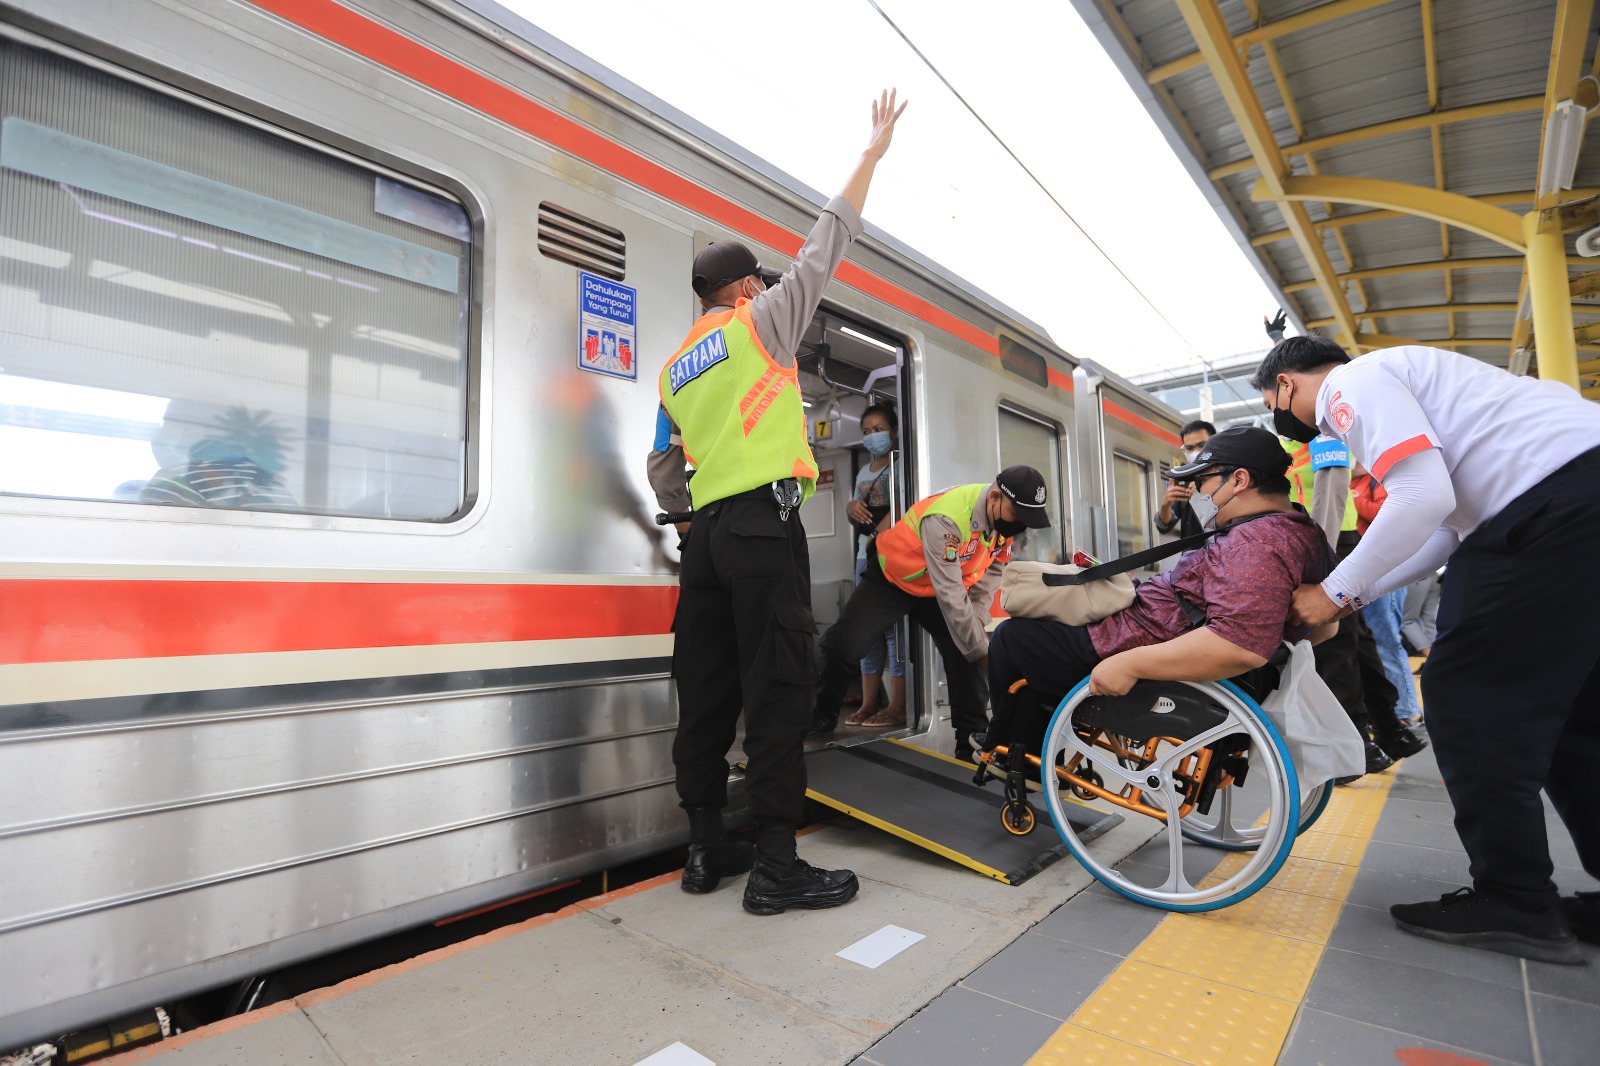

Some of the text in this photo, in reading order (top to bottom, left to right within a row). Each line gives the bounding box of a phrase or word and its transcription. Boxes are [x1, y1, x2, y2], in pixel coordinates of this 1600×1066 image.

[585, 279, 632, 302] Dahulukan
[585, 290, 632, 313] Penumpang
[588, 299, 630, 320] Yang Turun
[670, 332, 724, 389] SATPAM
[818, 421, 827, 437] 7
[1314, 450, 1347, 465] STASIONER
